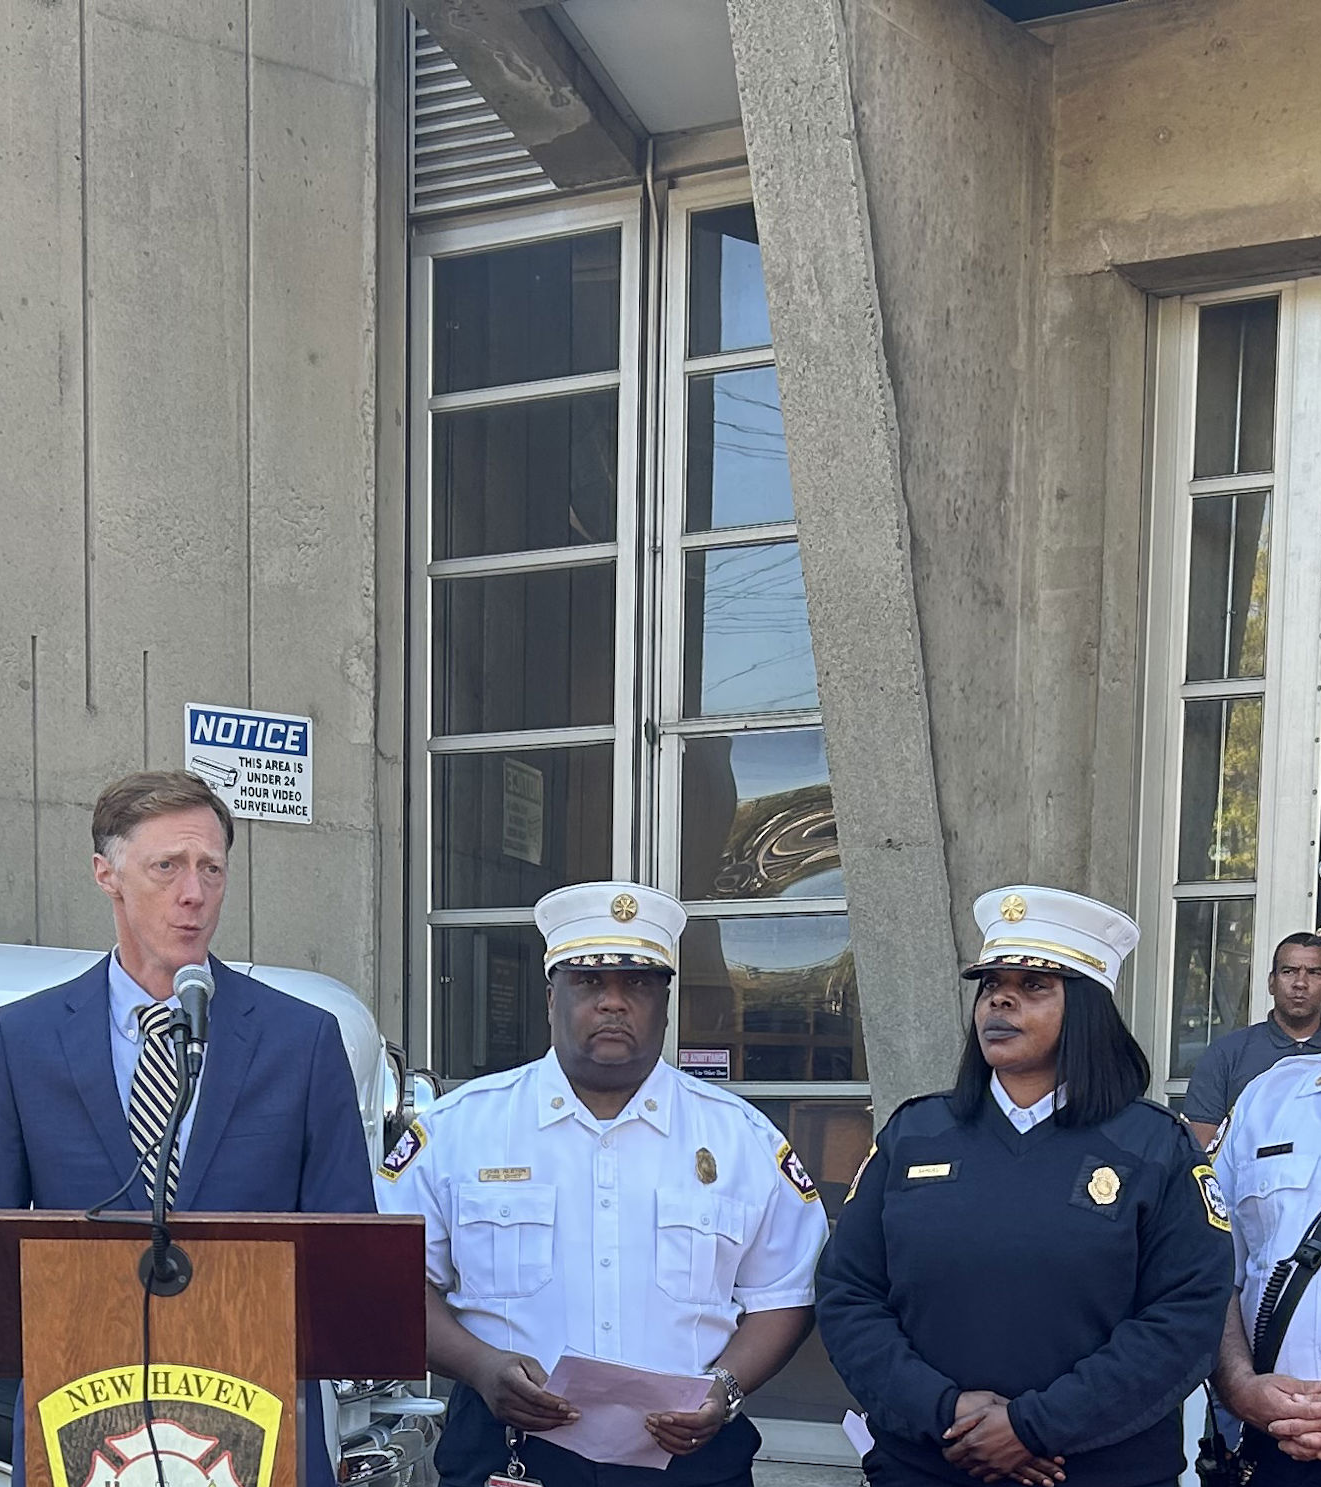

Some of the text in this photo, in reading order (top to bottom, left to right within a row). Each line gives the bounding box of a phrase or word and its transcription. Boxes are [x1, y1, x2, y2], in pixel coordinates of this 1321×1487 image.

[194, 714, 305, 752] NOTICE
[239, 756, 303, 773] THIS AREA IS
[247, 772, 296, 787] UNDER 24
[240, 786, 302, 802] HOUR VIDEO
[233, 799, 308, 816] SURVEILLANCE
[64, 1371, 260, 1412] NEW HAVEN
